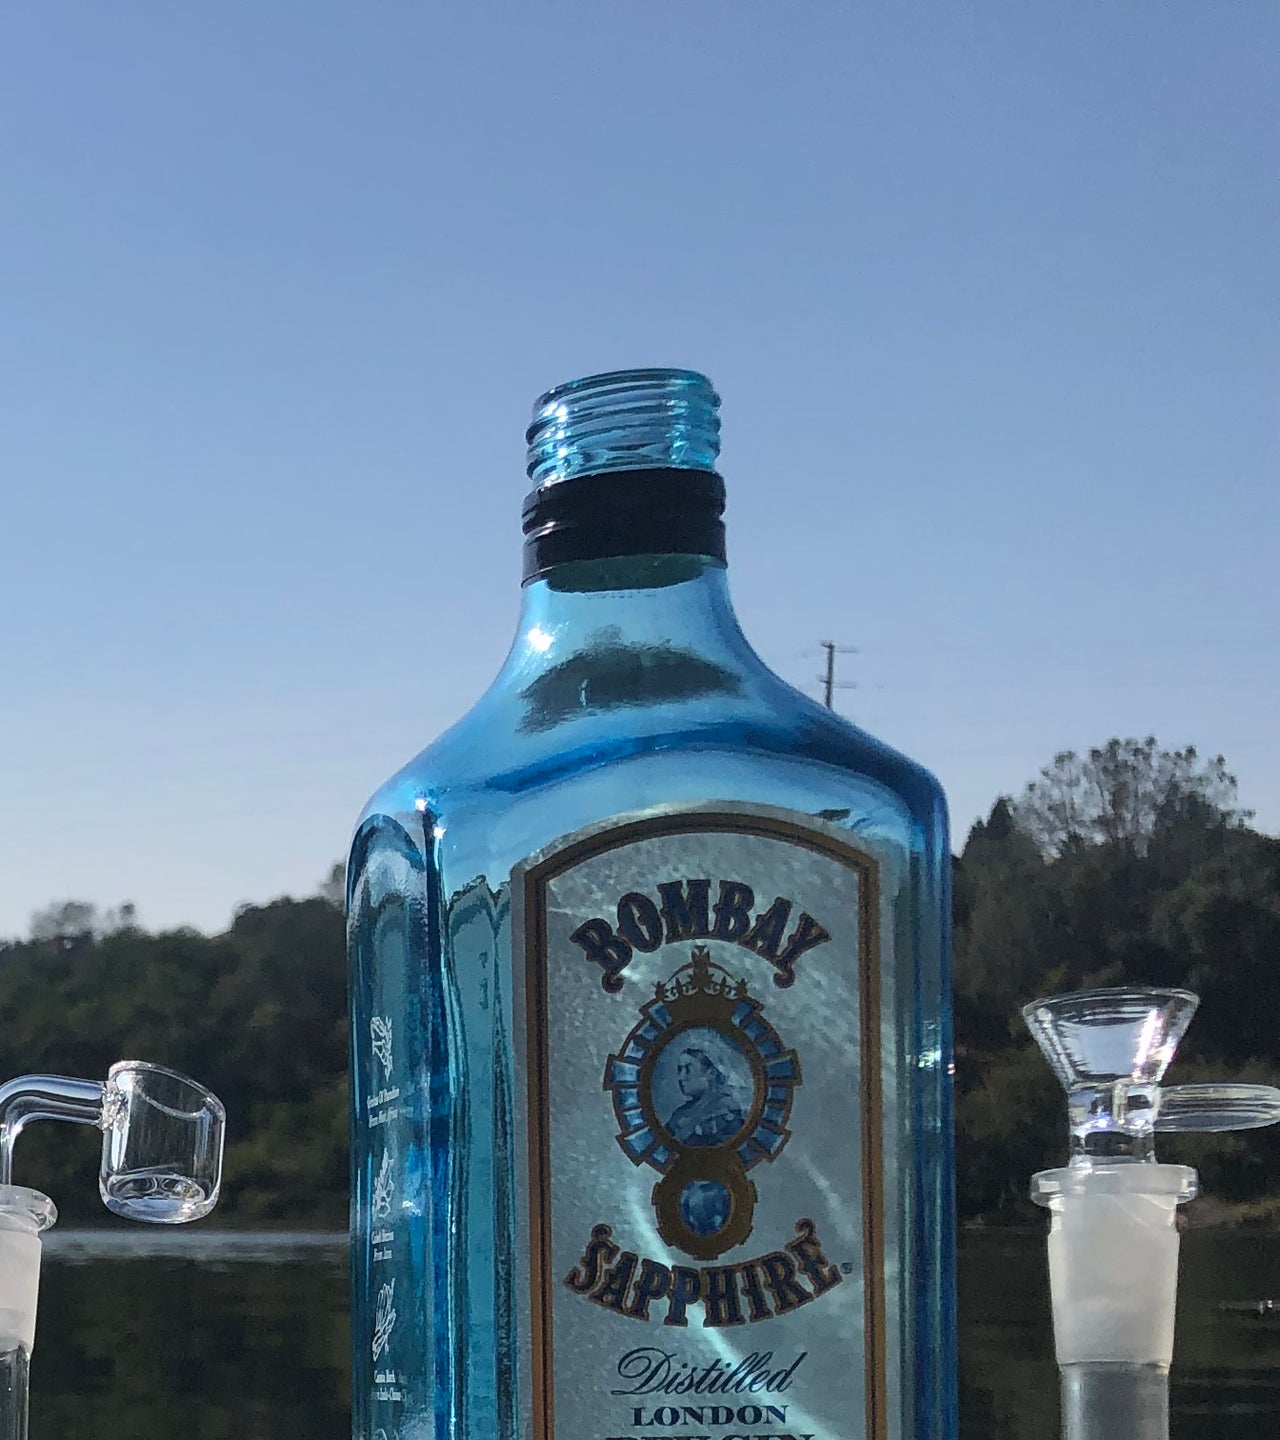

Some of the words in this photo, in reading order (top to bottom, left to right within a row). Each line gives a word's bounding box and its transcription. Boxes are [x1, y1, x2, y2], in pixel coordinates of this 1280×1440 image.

[569, 878, 832, 994] BOMBAY
[563, 1218, 842, 1328] SAPPHIRE
[611, 1346, 808, 1397] Distilled
[631, 1405, 788, 1427] LONDON
